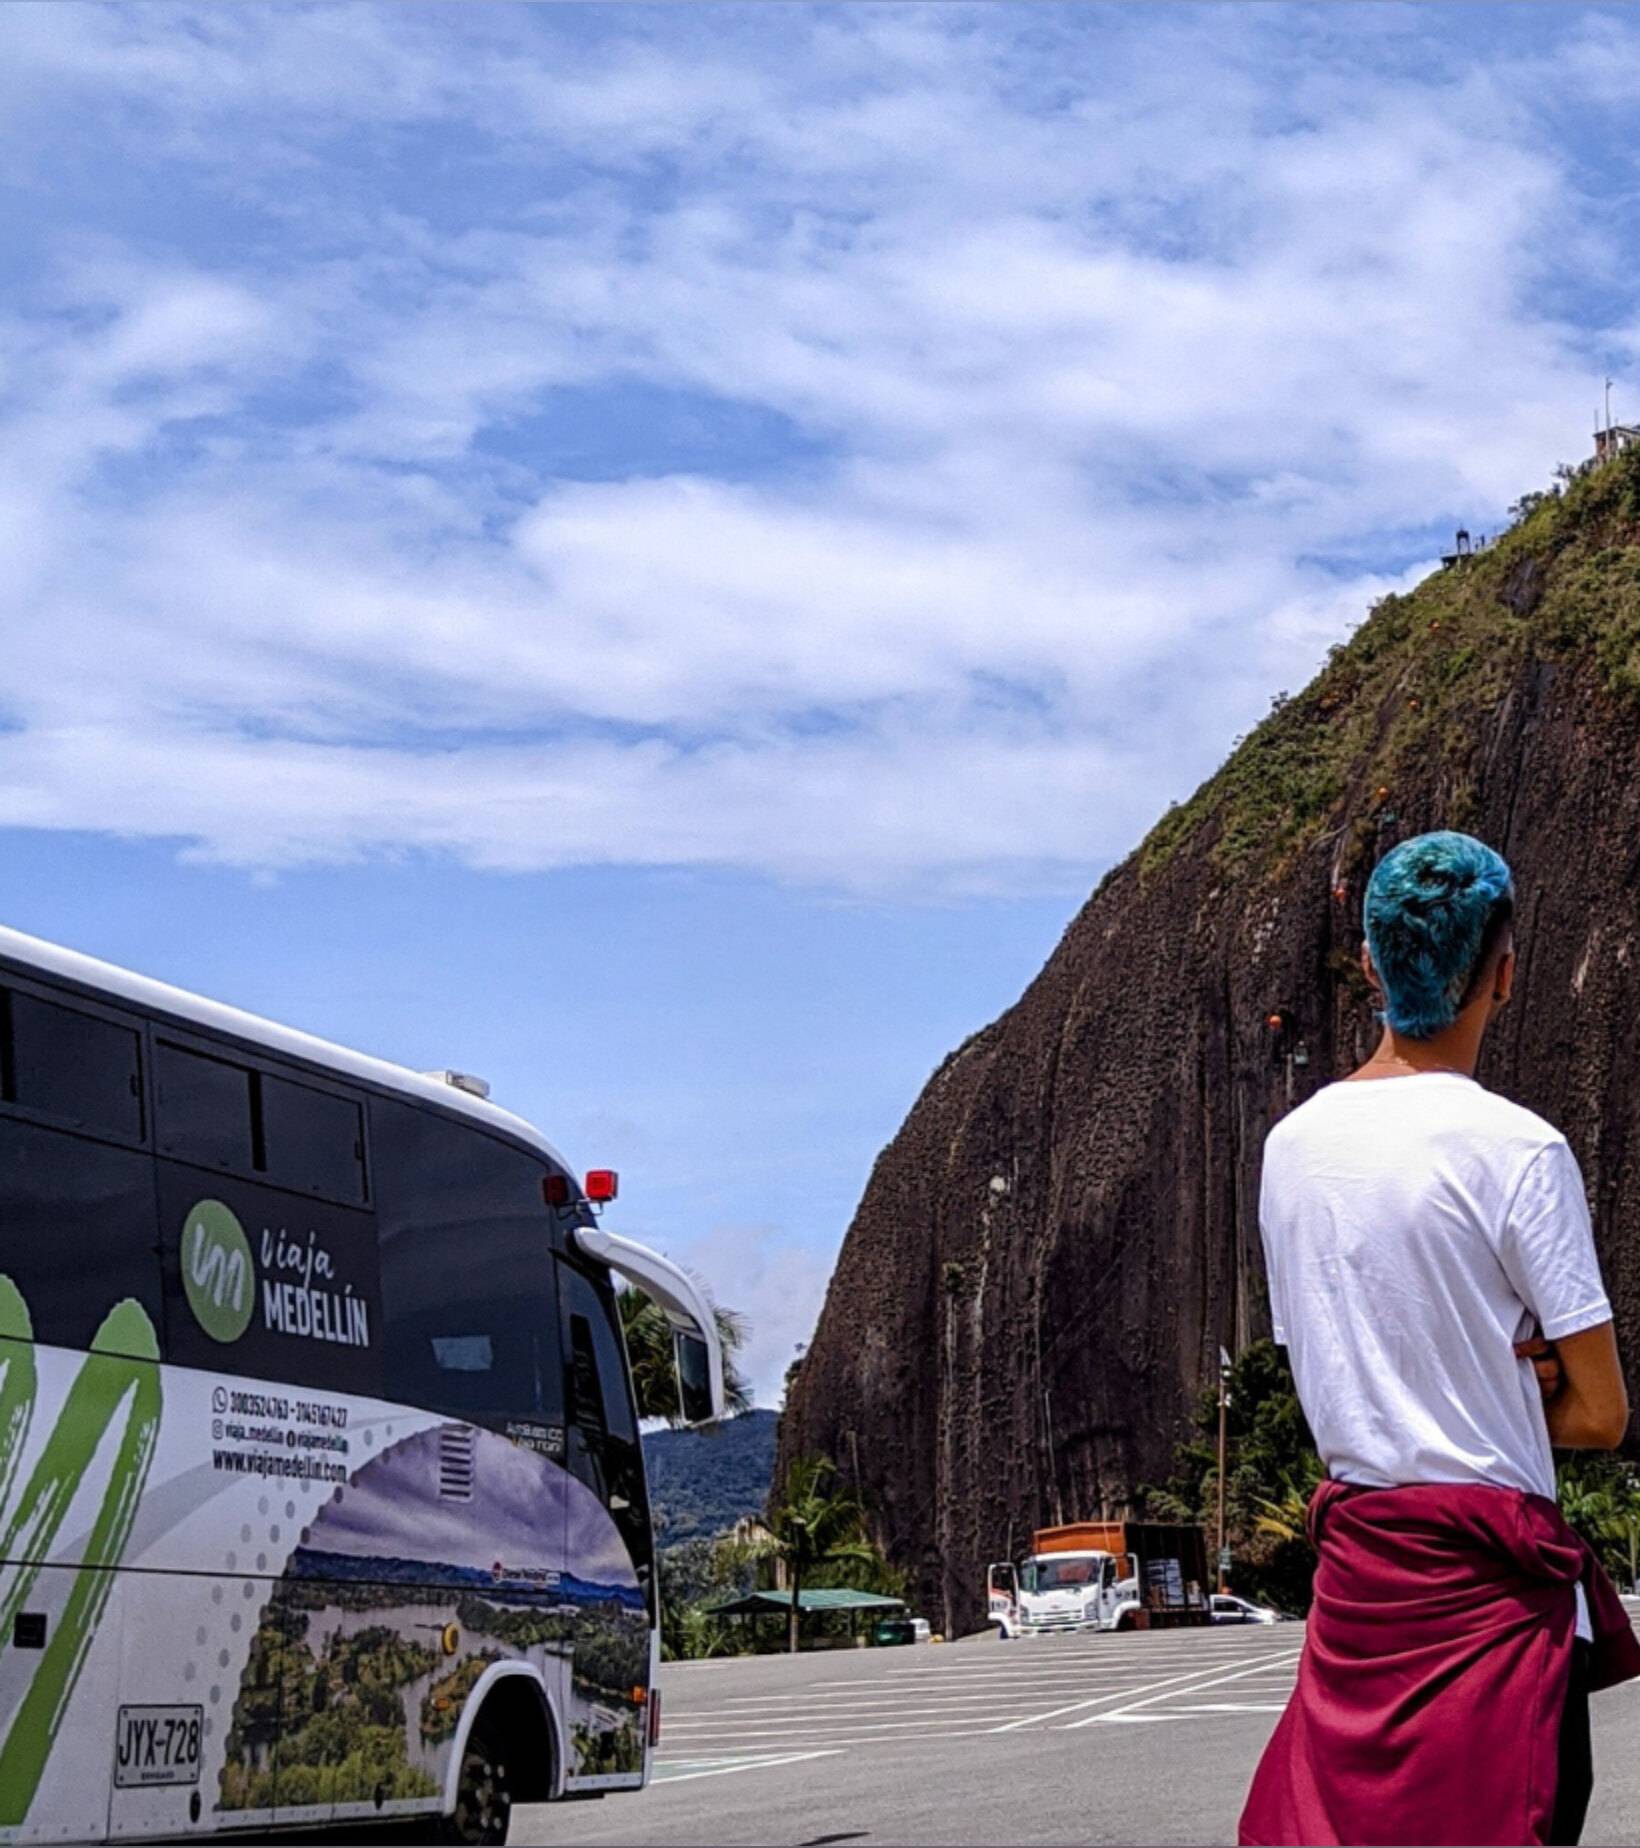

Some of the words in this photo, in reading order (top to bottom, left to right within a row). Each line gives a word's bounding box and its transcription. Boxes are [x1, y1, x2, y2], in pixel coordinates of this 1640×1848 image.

[260, 1228, 335, 1290] Viaja
[262, 1279, 370, 1348] MEDELLÍN
[119, 1719, 199, 1767] JYX-728
